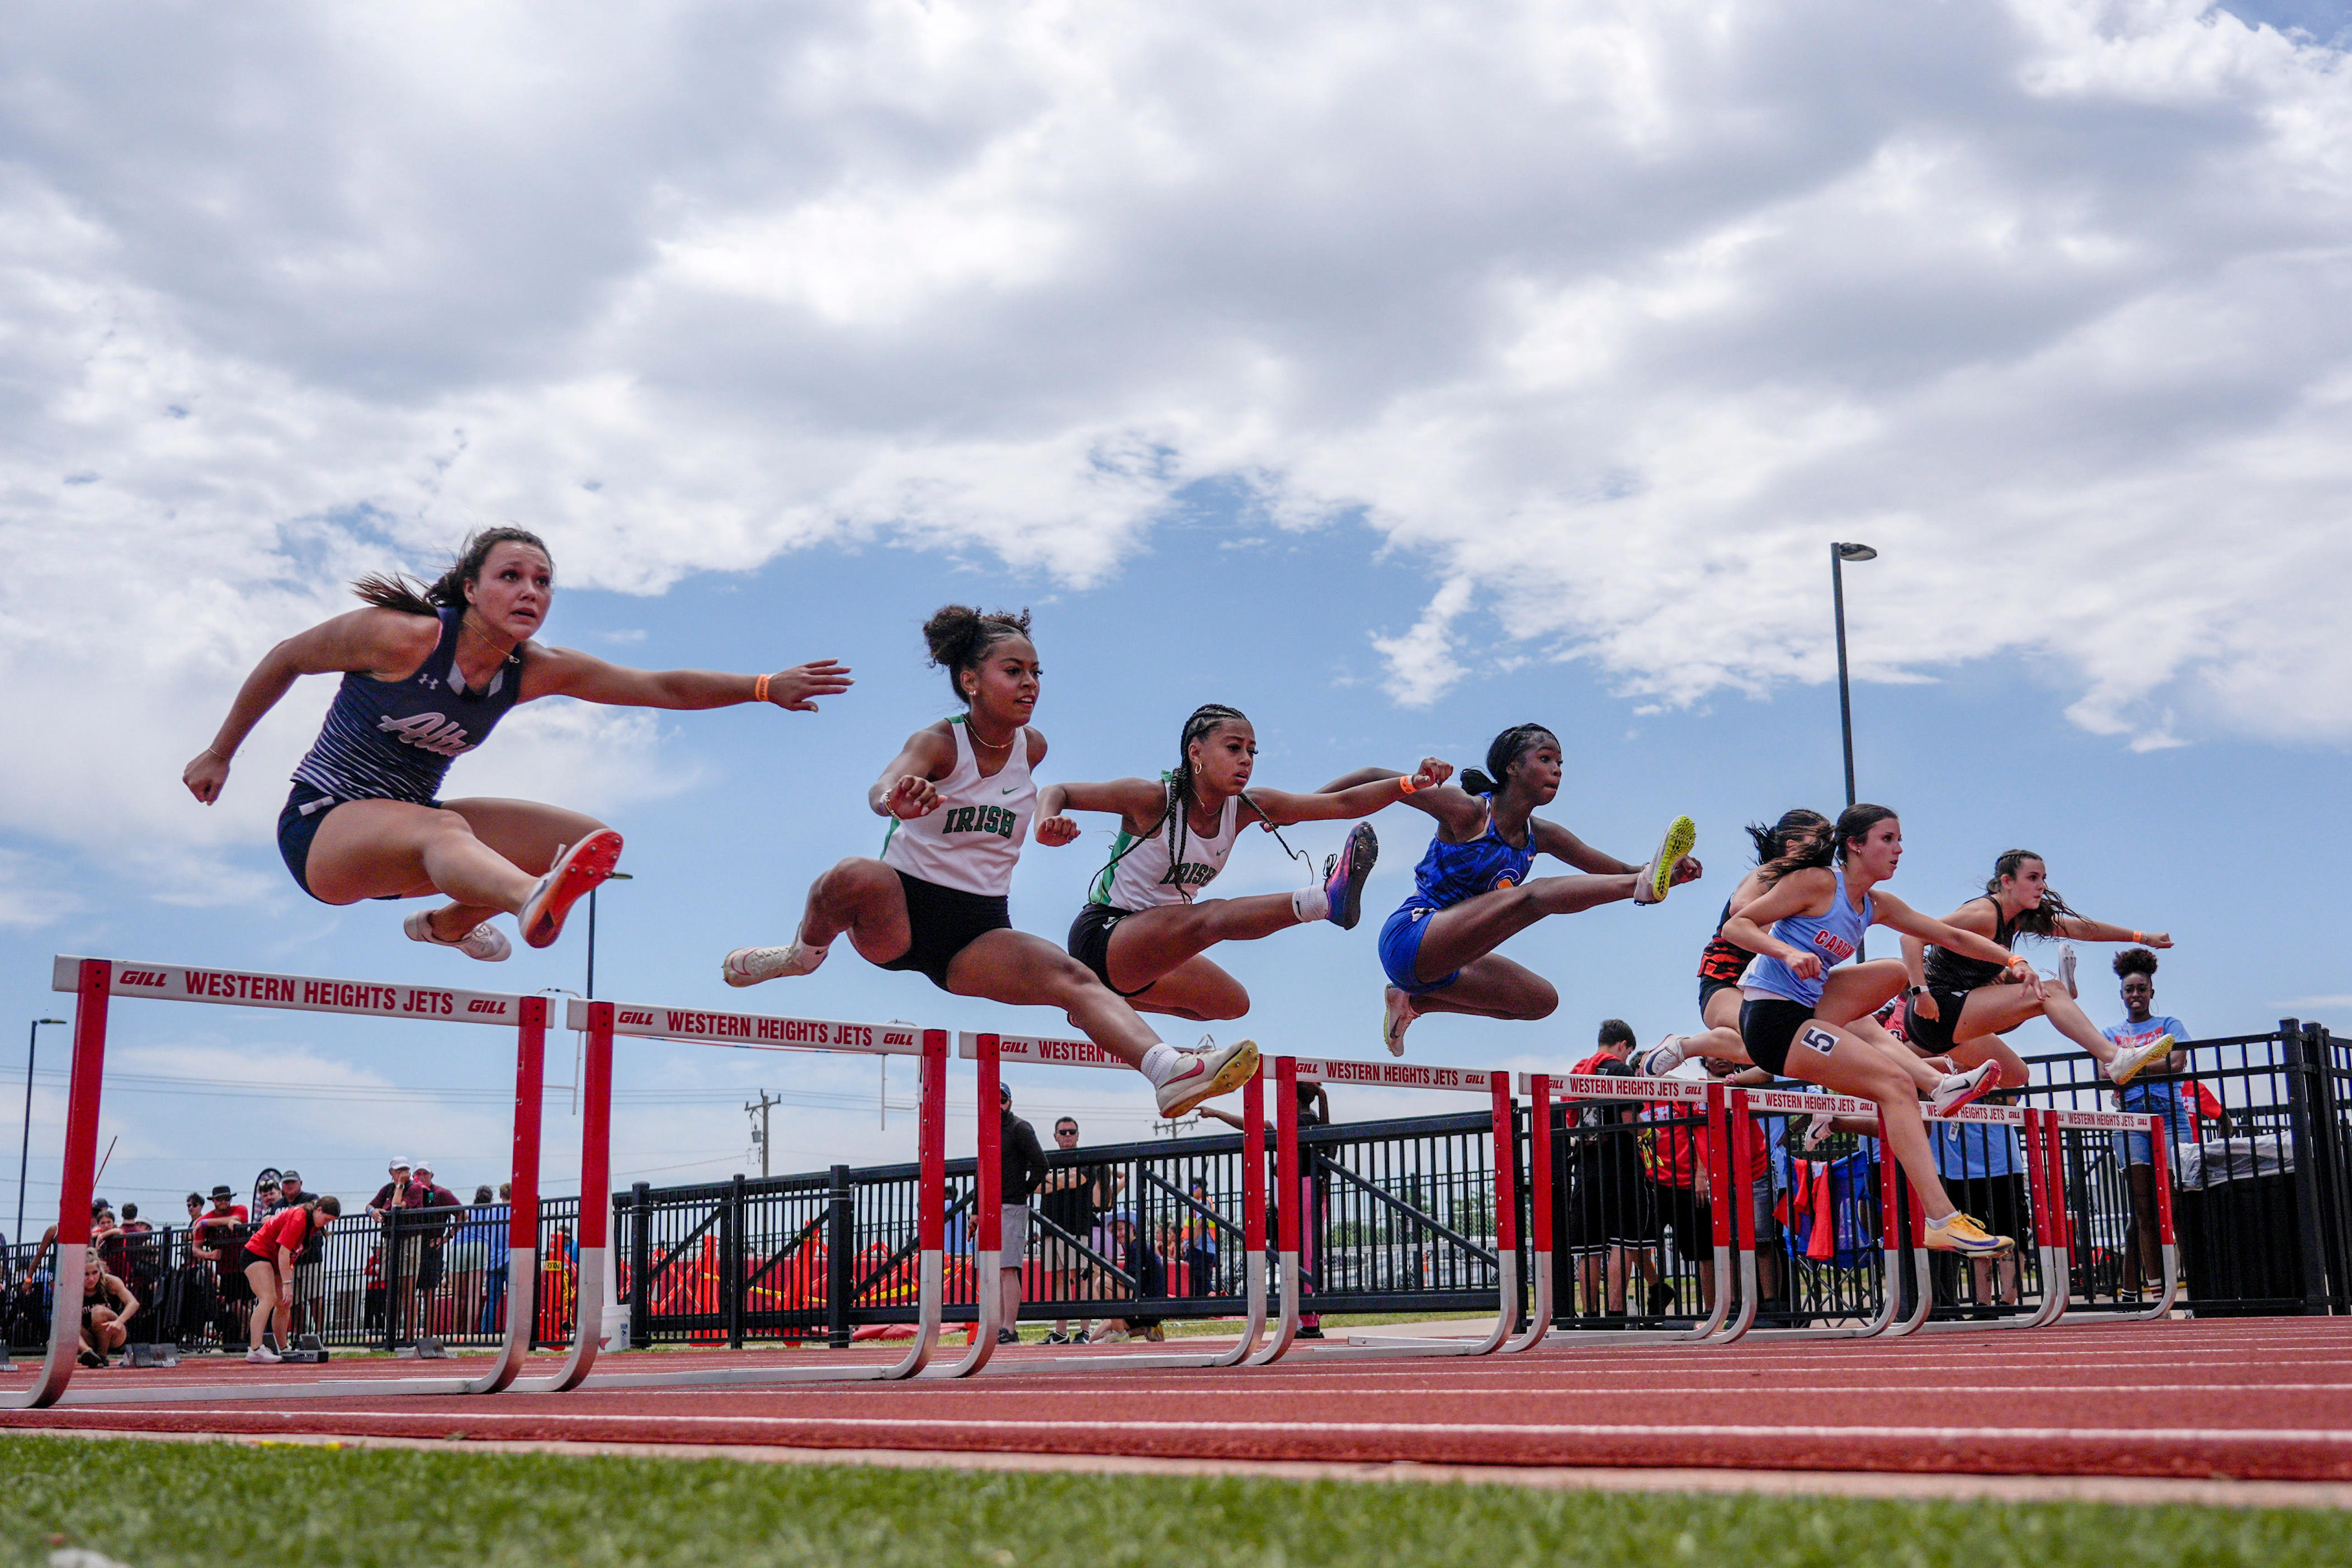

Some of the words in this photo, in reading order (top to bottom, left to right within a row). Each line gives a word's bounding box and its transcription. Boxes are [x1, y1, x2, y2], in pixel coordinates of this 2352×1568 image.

[943, 805, 1017, 839] IRISH
[1159, 862, 1218, 886] IRISH
[119, 970, 167, 987] GILL
[185, 971, 295, 1003] WESTERN
[304, 981, 396, 1010] HEIGHTS
[403, 990, 454, 1015] JETS
[467, 999, 507, 1015] GILL
[617, 1011, 654, 1026] GILL
[666, 1010, 751, 1037] WESTERN
[757, 1018, 829, 1043] HEIGHTS
[833, 1025, 872, 1047] JETS
[883, 1033, 913, 1046] GILL
[1803, 1028, 1835, 1052] 5
[1000, 1041, 1028, 1054] GILL
[1038, 1040, 1105, 1062] WESTERN
[1296, 1063, 1318, 1074] GILL
[1326, 1061, 1380, 1081] WESTERN
[1383, 1065, 1430, 1085] HEIGHTS
[1433, 1069, 1459, 1087] JETS
[1465, 1074, 1485, 1085] GILL
[1570, 1078, 1613, 1094] WESTERN
[1616, 1080, 1655, 1096] HEIGHTS
[1657, 1082, 1679, 1097] JETS
[1685, 1085, 1702, 1095] GILL
[1765, 1093, 1802, 1109] WESTERN
[1805, 1095, 1836, 1111] HEIGHTS
[1838, 1098, 1855, 1112] JETS
[1859, 1102, 1873, 1111] GILL
[1961, 1106, 1988, 1120] HEIGHTS
[1990, 1108, 2005, 1120] JETS
[2068, 1112, 2095, 1125] WESTERN
[2097, 1114, 2120, 1126] HEIGHTS
[2122, 1116, 2134, 1127] JETS
